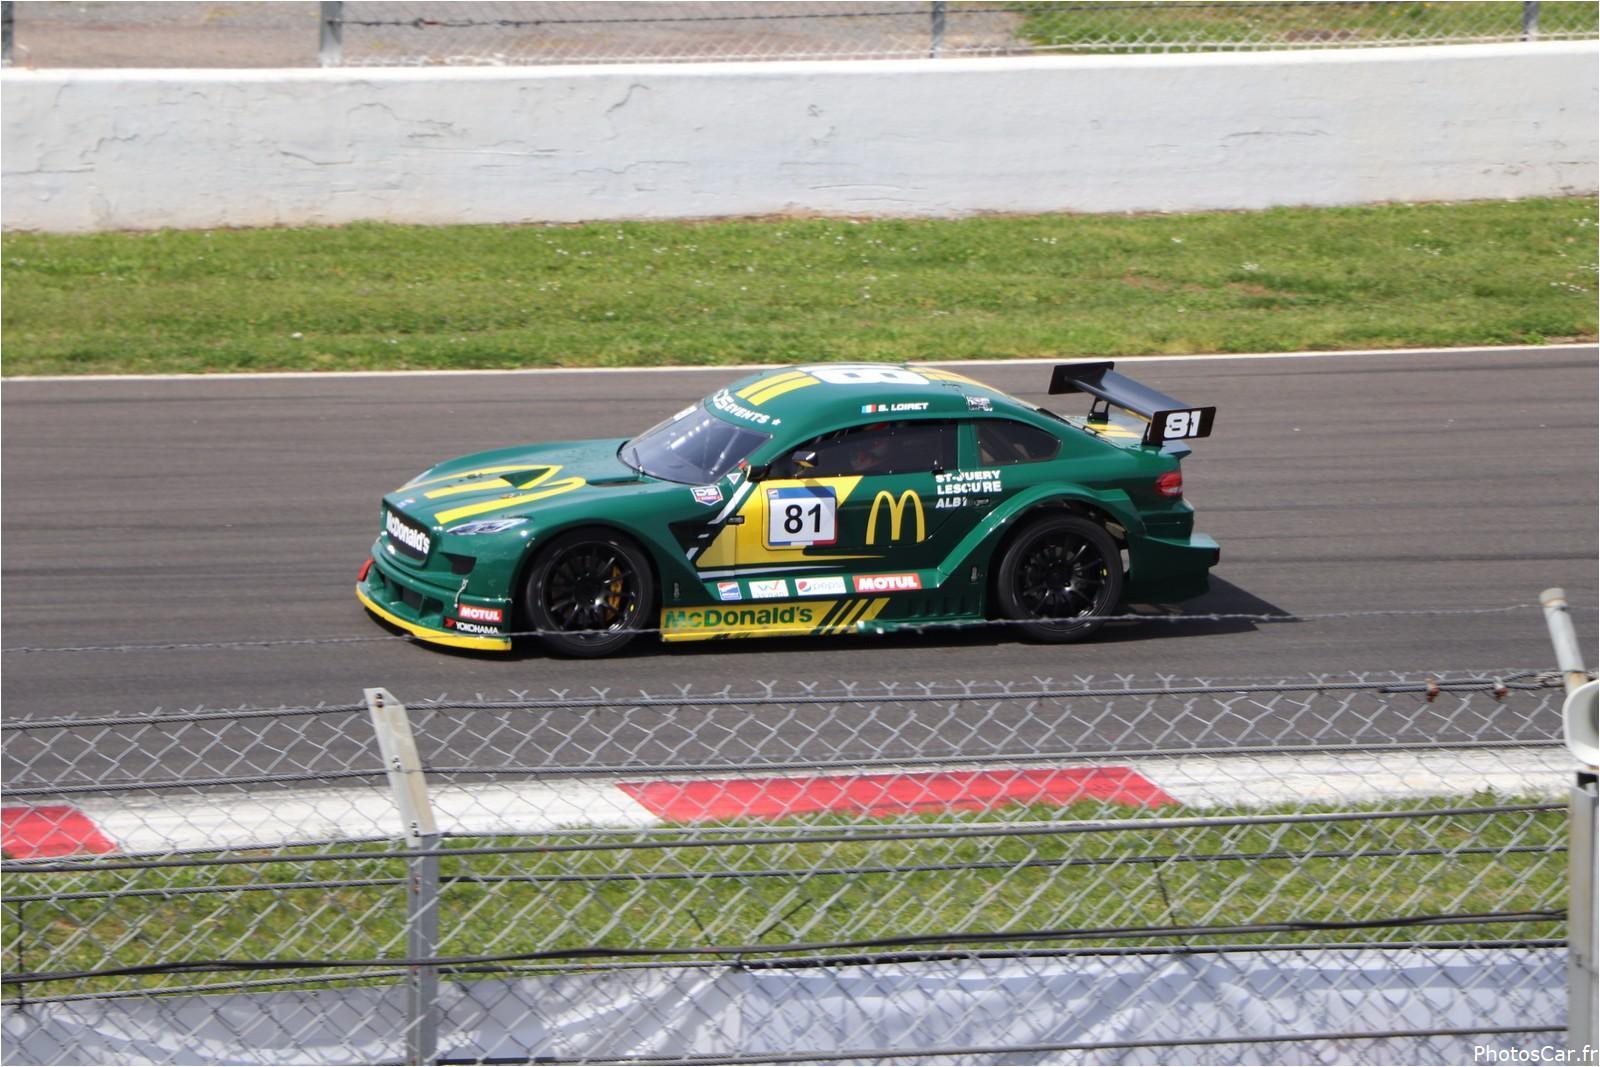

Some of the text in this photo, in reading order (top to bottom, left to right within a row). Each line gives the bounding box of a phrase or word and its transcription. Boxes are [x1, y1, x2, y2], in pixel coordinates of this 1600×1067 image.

[724, 403, 771, 424] EVENTS
[890, 402, 929, 411] LOIRET
[1165, 410, 1201, 438] 81
[783, 503, 821, 534] 81
[858, 575, 918, 591] MOTUL
[460, 606, 500, 621] MOTUL
[663, 606, 814, 629] McDonald's
[455, 621, 500, 634] YOKOHAMA
